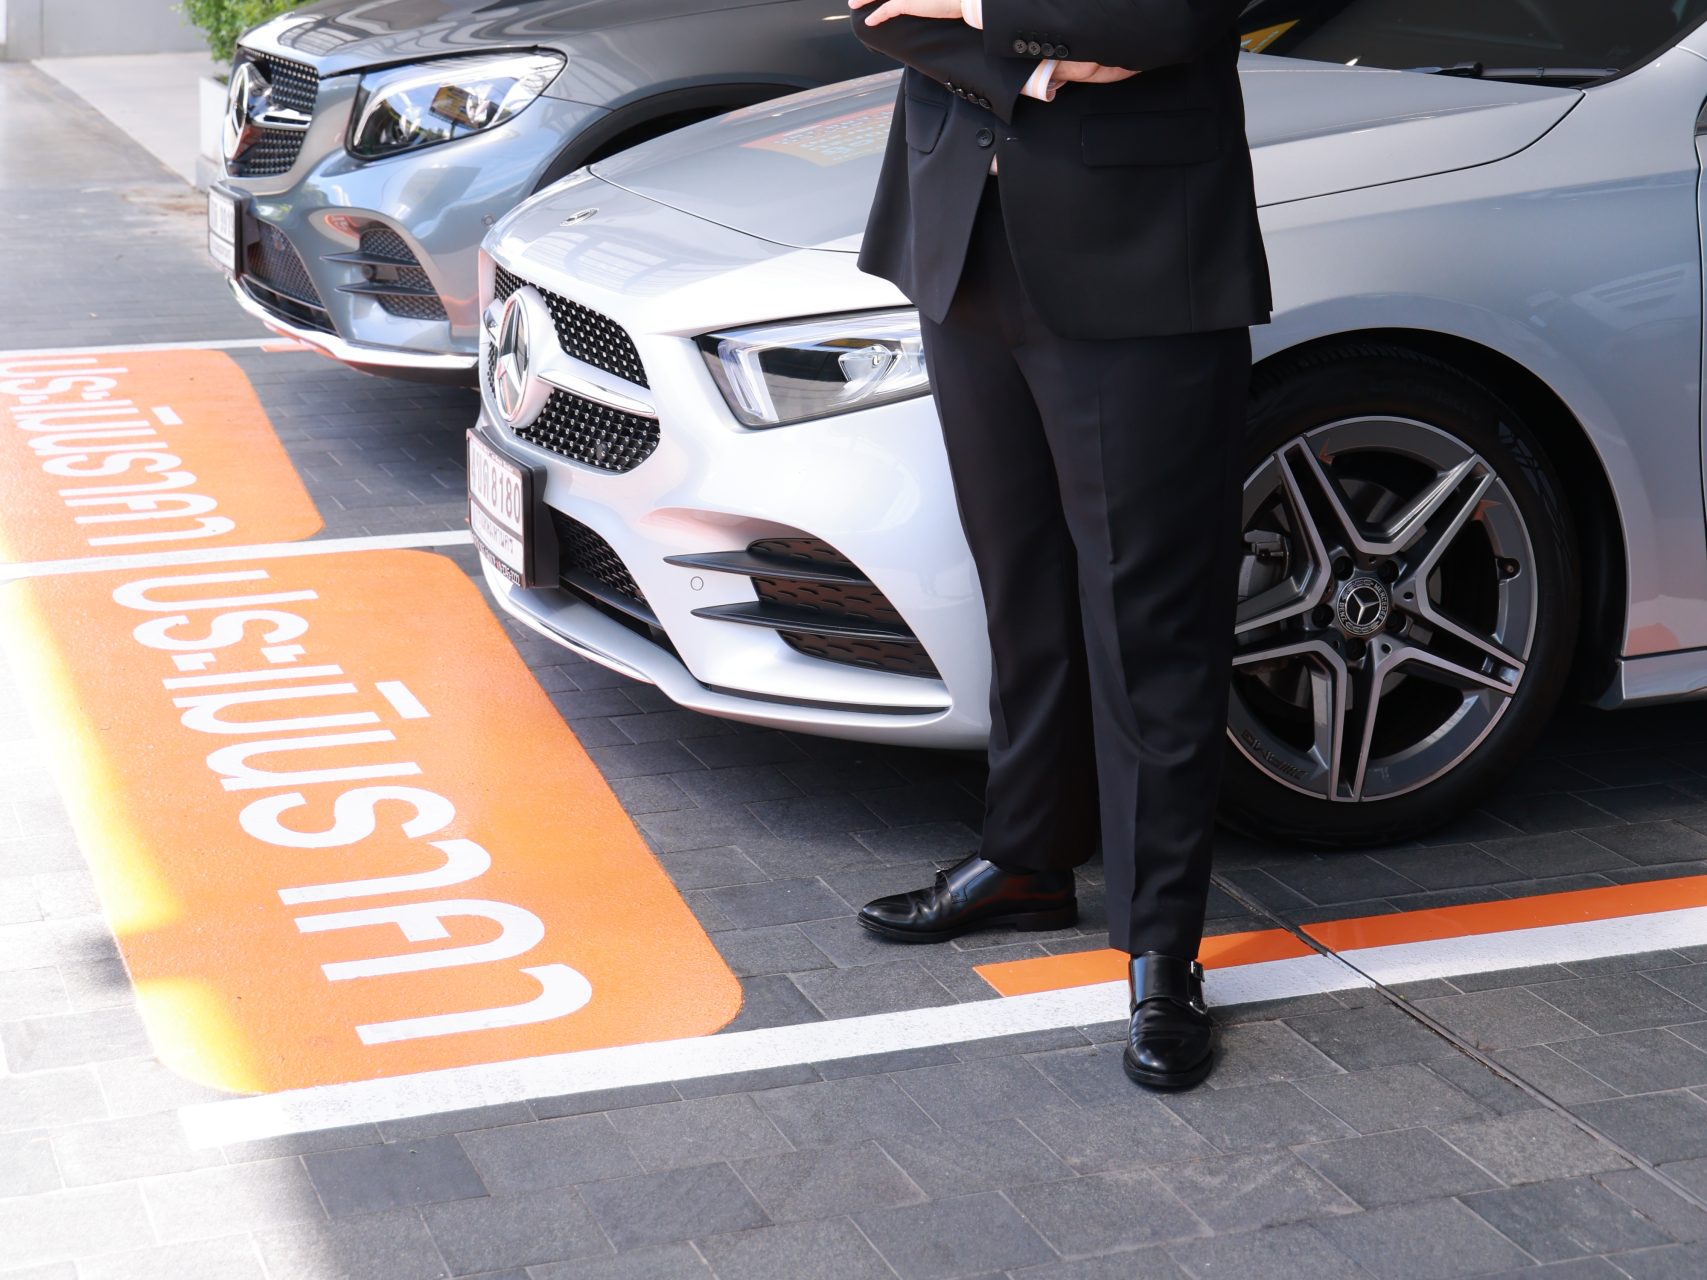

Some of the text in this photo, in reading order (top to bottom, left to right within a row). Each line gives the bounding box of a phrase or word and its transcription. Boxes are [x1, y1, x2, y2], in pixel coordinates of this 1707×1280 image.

[491, 465, 520, 524] 8180
[112, 569, 593, 1046] ประเมินราคา
